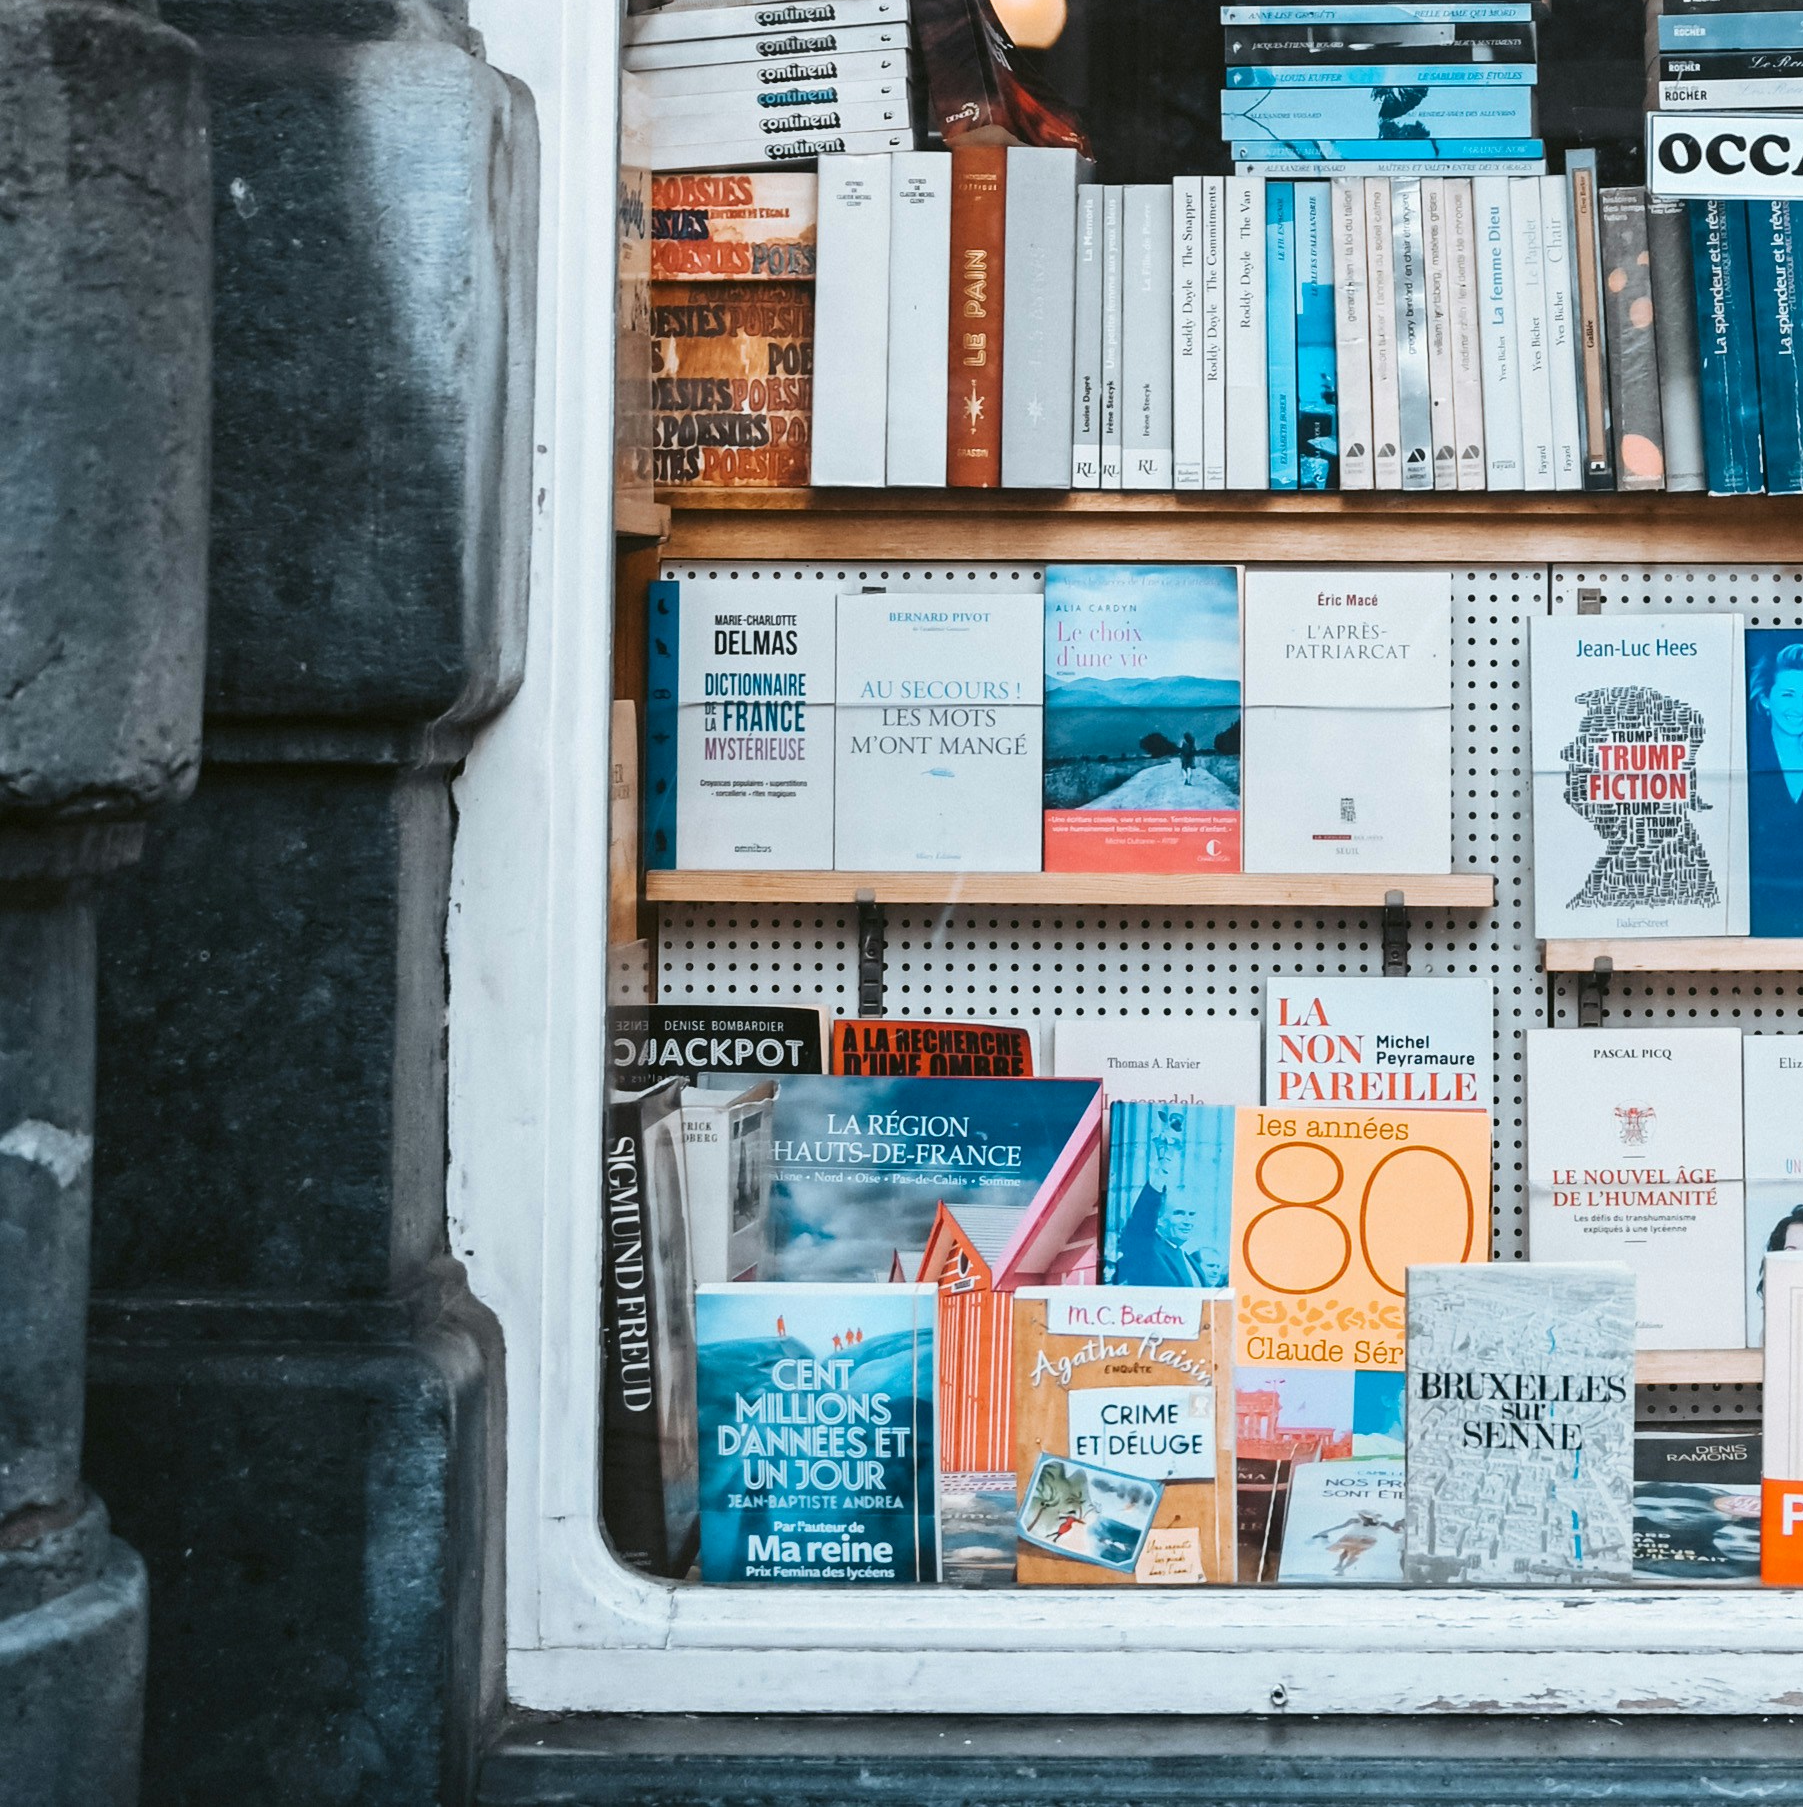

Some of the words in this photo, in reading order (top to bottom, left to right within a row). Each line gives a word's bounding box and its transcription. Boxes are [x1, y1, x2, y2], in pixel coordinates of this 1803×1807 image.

[755, 4, 836, 26] continent
[756, 34, 837, 56] continent
[757, 61, 838, 83] continent
[757, 87, 838, 107] continent
[1665, 90, 1708, 101] ROCHER
[759, 111, 841, 133] continent
[765, 137, 845, 159] continent
[1183, 192, 1196, 241] Snapper
[1488, 206, 1500, 245] Dieu
[1183, 245, 1193, 267] The
[964, 249, 987, 318] PAIN
[1491, 251, 1503, 304] femme
[1182, 279, 1196, 313] Doyle
[1492, 308, 1505, 325] La
[963, 333, 987, 367] LE
[1182, 319, 1196, 356] Roddy
[1318, 592, 1342, 607] Éric
[1346, 593, 1378, 607] Macé
[715, 614, 797, 626] MARIE-CHARLOTTE
[889, 612, 948, 622] BERNARD
[952, 612, 991, 622] PIVOT
[714, 630, 798, 656] DELMAS
[1057, 621, 1082, 643] Le
[1089, 621, 1142, 643] choix
[1307, 623, 1388, 640] L'APRÈS-
[1056, 646, 1112, 668] d'une
[1121, 646, 1148, 668] vie
[1285, 644, 1411, 660] PATRIARCAT
[1576, 639, 1651, 657] Jean-Luc
[1656, 639, 1697, 657] Hees
[705, 673, 806, 697] DICTIONNAIRE
[861, 681, 893, 698] AU
[900, 681, 1009, 699] SECOURS
[723, 701, 806, 732] FRANCE
[882, 709, 921, 727] LES
[929, 709, 996, 727] MOTS
[704, 733, 806, 761] MYSTÉRIEUSE
[851, 736, 932, 755] M'ONT
[940, 733, 1027, 755] MANGÉ
[1598, 744, 1686, 771] TRUMP
[1589, 773, 1687, 801] FICTION
[1277, 997, 1331, 1027] LA
[664, 1020, 707, 1032] DENISE
[711, 1020, 784, 1032] BOMBARDIER
[648, 1037, 803, 1067] JACKPOT
[1278, 1035, 1365, 1064] NON
[1376, 1035, 1430, 1049] Michel
[1376, 1051, 1475, 1067] Peyramaure
[1278, 1071, 1477, 1102] PAREILLE
[828, 1113, 859, 1136] LA
[868, 1109, 970, 1137] RÉGION
[1256, 1114, 1296, 1137] les
[1306, 1117, 1409, 1141] années
[772, 1140, 1022, 1167] HAUTS-DE-FRANCE
[1553, 1169, 1577, 1185] LE
[1584, 1169, 1671, 1185] NOUVEL
[1677, 1165, 1718, 1184] ÂGE
[1553, 1191, 1581, 1207] DE
[1587, 1188, 1718, 1207] L'HUMANITÉ
[606, 1136, 646, 1289] SIGMUND
[617, 1295, 653, 1412] FREUD
[772, 1358, 854, 1392] CENT
[1418, 1372, 1627, 1403] BRUXELLES
[736, 1392, 891, 1426] MILLIONS
[1101, 1404, 1178, 1425] CRIME
[1501, 1402, 1547, 1420] sur
[717, 1423, 867, 1459] D'ANNÉES
[876, 1426, 910, 1458] ET
[1077, 1436, 1099, 1456] ET
[1109, 1431, 1202, 1455] DÉLUGE
[1463, 1420, 1582, 1450] SENNE
[742, 1460, 787, 1490] UN
[795, 1460, 886, 1491] JOUR
[748, 1534, 802, 1562] Ma
[807, 1534, 894, 1563] reine
